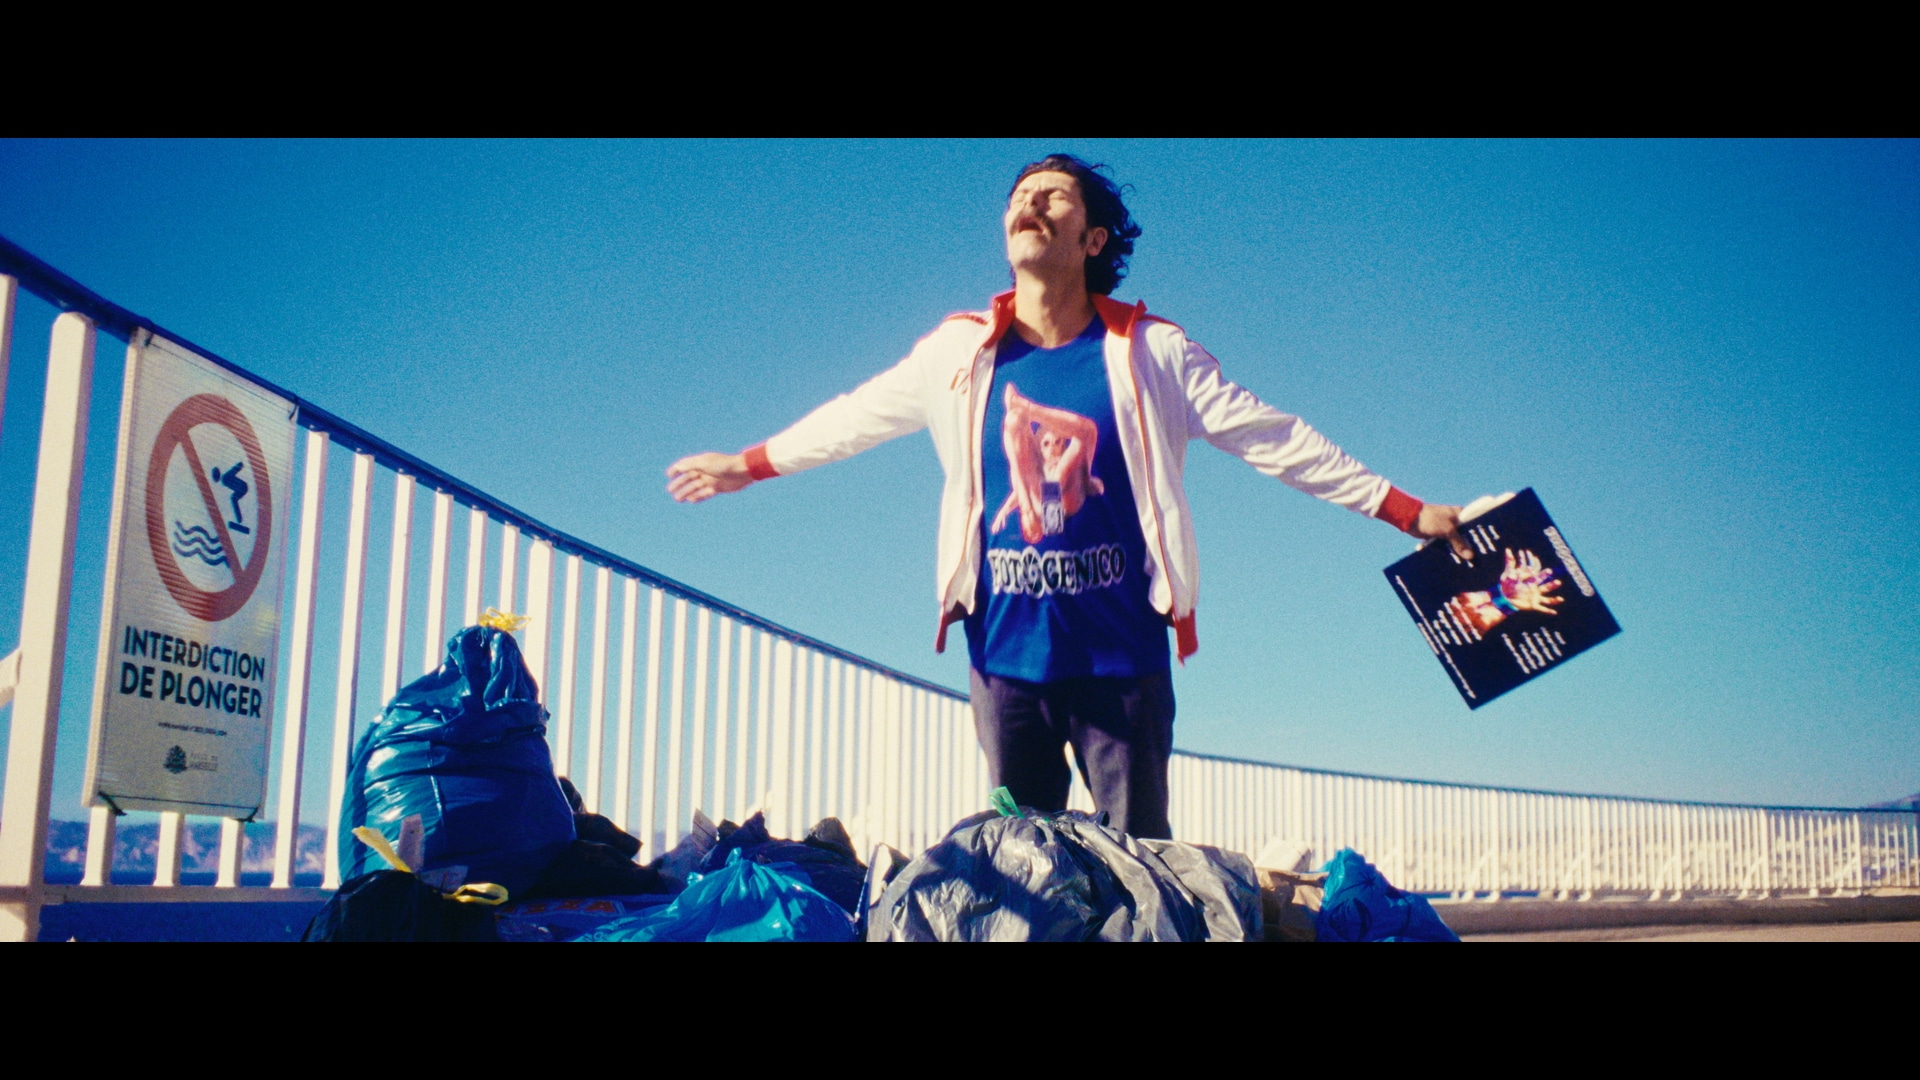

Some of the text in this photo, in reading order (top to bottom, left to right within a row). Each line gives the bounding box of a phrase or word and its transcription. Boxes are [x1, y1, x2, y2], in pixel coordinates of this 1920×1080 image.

[123, 625, 265, 682] INTERDICTION
[119, 661, 263, 718] DE PLONGER
